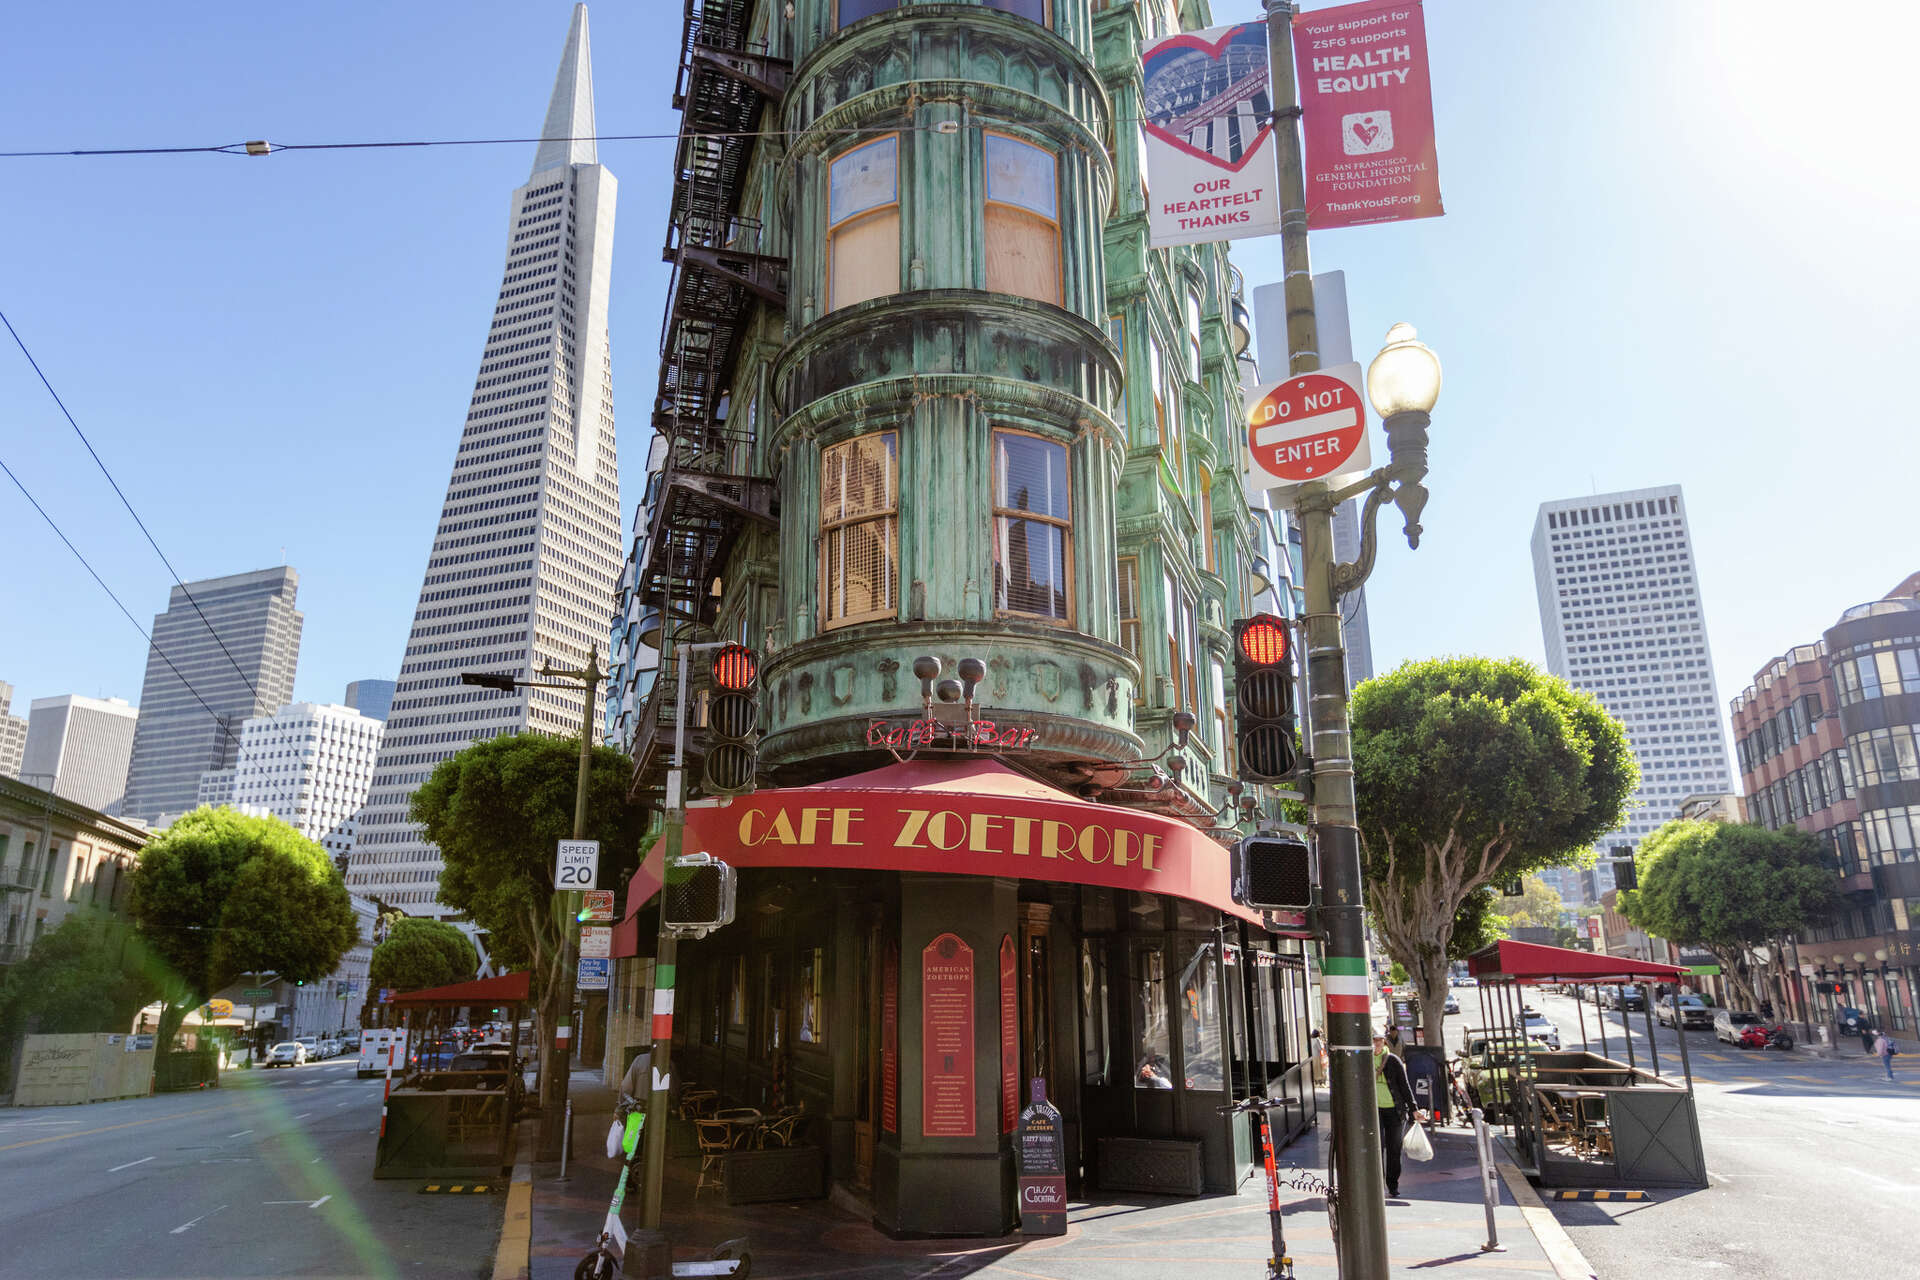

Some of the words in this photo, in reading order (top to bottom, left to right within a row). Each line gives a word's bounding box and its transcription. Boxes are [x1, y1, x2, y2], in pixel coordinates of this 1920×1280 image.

[1306, 25, 1334, 35] Your
[1338, 14, 1387, 30] support
[1391, 11, 1410, 21] for
[1312, 37, 1347, 49] ZSFG
[1350, 29, 1407, 45] supports
[1312, 45, 1410, 72] HEALTH
[1317, 67, 1410, 94] EQUITY
[1315, 169, 1368, 182] GENERAL
[1370, 162, 1428, 178] HOSPITAL
[1334, 163, 1352, 171] SAN
[1354, 157, 1407, 170] FRANCISCO
[1193, 179, 1231, 194] OUR
[1332, 174, 1412, 191] FOUNDATION
[1163, 188, 1263, 214] HEARTFELT
[1326, 194, 1421, 212] ThankYouSF.org
[1178, 210, 1250, 230] THANKS
[1263, 401, 1291, 421] DO
[1304, 388, 1344, 412] NOT
[1275, 437, 1341, 464] ENTER
[973, 720, 1036, 748] Bar
[738, 807, 865, 848] CAFE
[893, 809, 1163, 873] ZOETROPE
[561, 846, 595, 855] SPEED
[564, 856, 590, 864] LIMIT
[561, 866, 592, 884] 20
